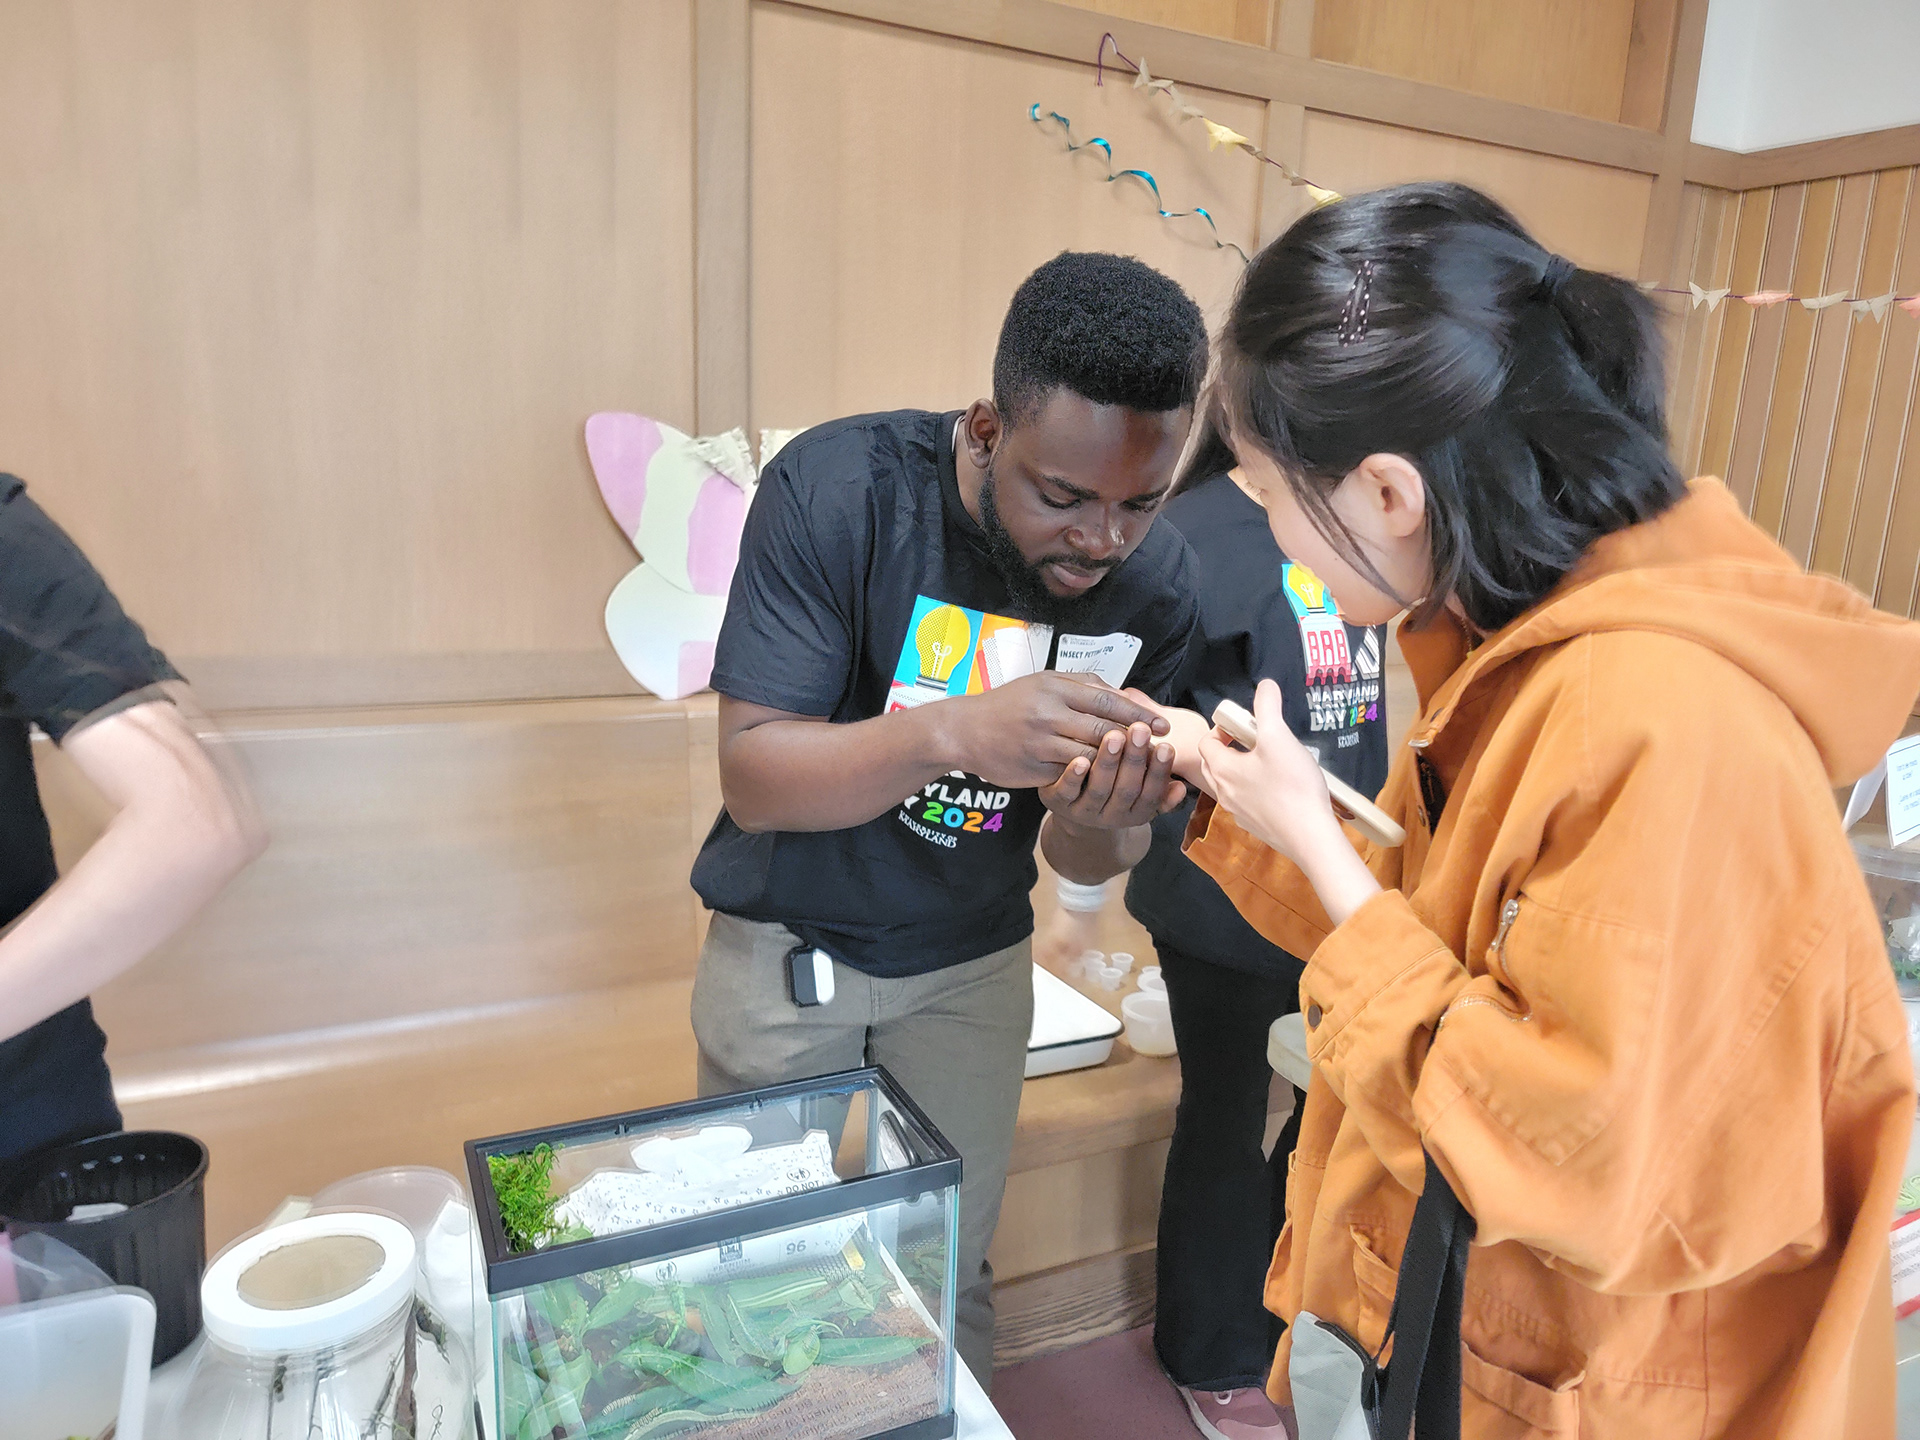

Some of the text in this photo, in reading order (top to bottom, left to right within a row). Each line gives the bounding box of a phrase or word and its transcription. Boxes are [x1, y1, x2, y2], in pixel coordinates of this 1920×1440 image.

[1060, 650, 1084, 659] INSECT
[1310, 704, 1347, 731] DAY
[923, 782, 1011, 810] YLAND
[922, 801, 1004, 833] 2024
[785, 1179, 819, 1194] DO NOT
[786, 1239, 807, 1255] 96
